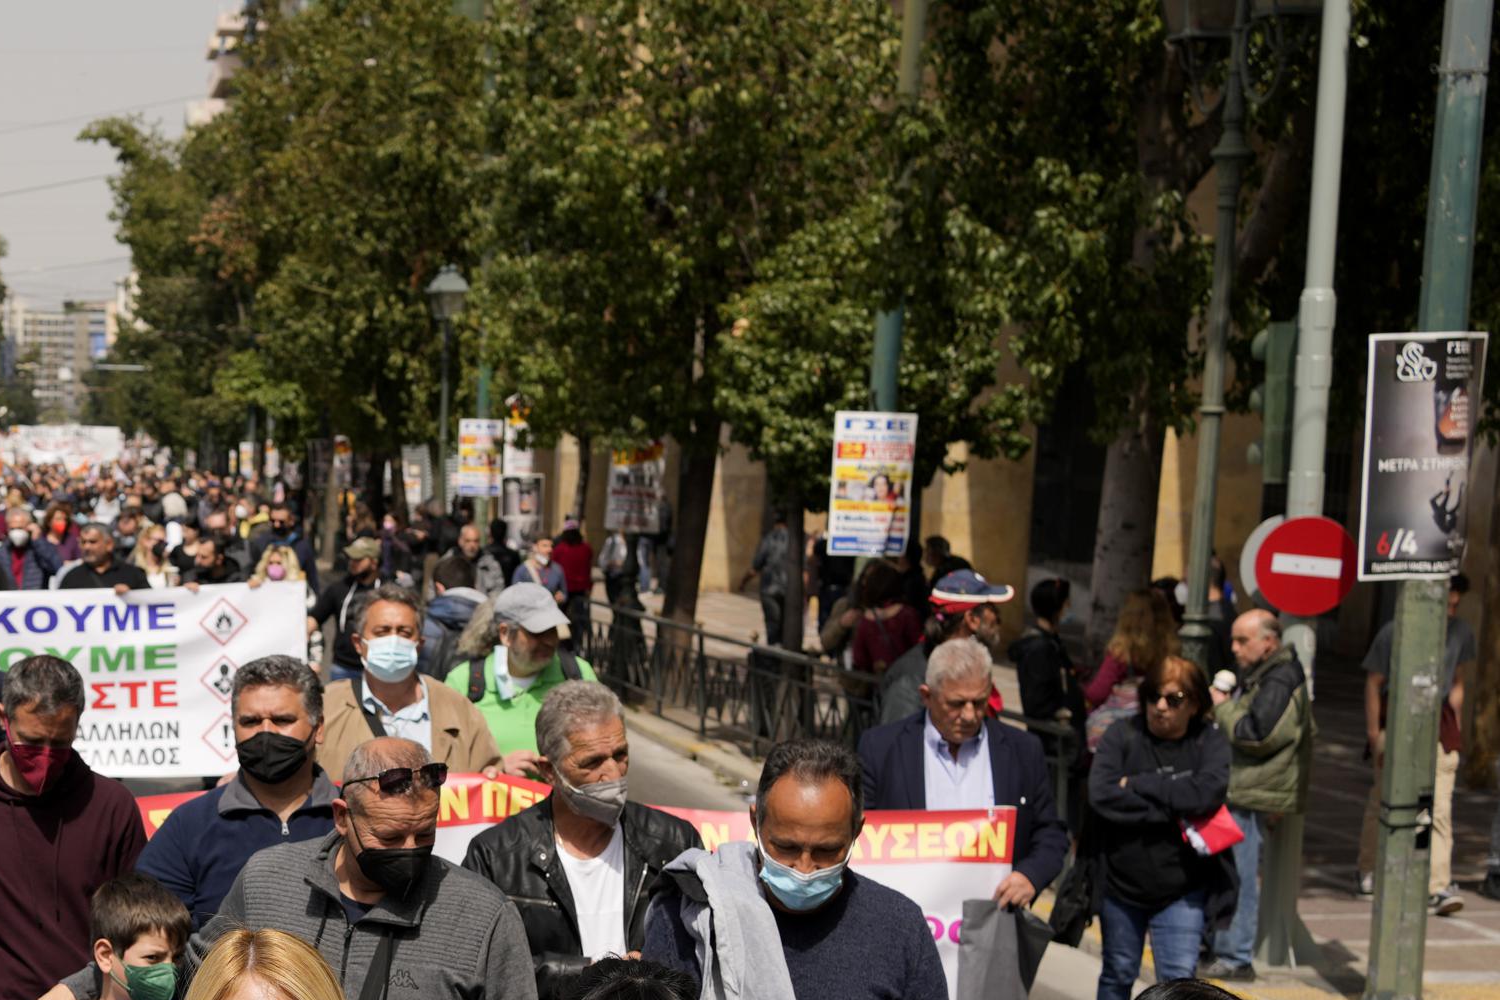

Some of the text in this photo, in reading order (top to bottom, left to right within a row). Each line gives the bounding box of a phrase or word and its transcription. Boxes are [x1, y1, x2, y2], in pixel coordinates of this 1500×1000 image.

[1378, 459, 1419, 473] ΜΕΤΡΑ
[1376, 528, 1418, 560] 6/4
[86, 680, 178, 709] ΣΤΕ
[76, 721, 180, 741] ΑΛΛΗΛΩΝ
[852, 821, 1007, 860] ΥΣΕΩΝ
